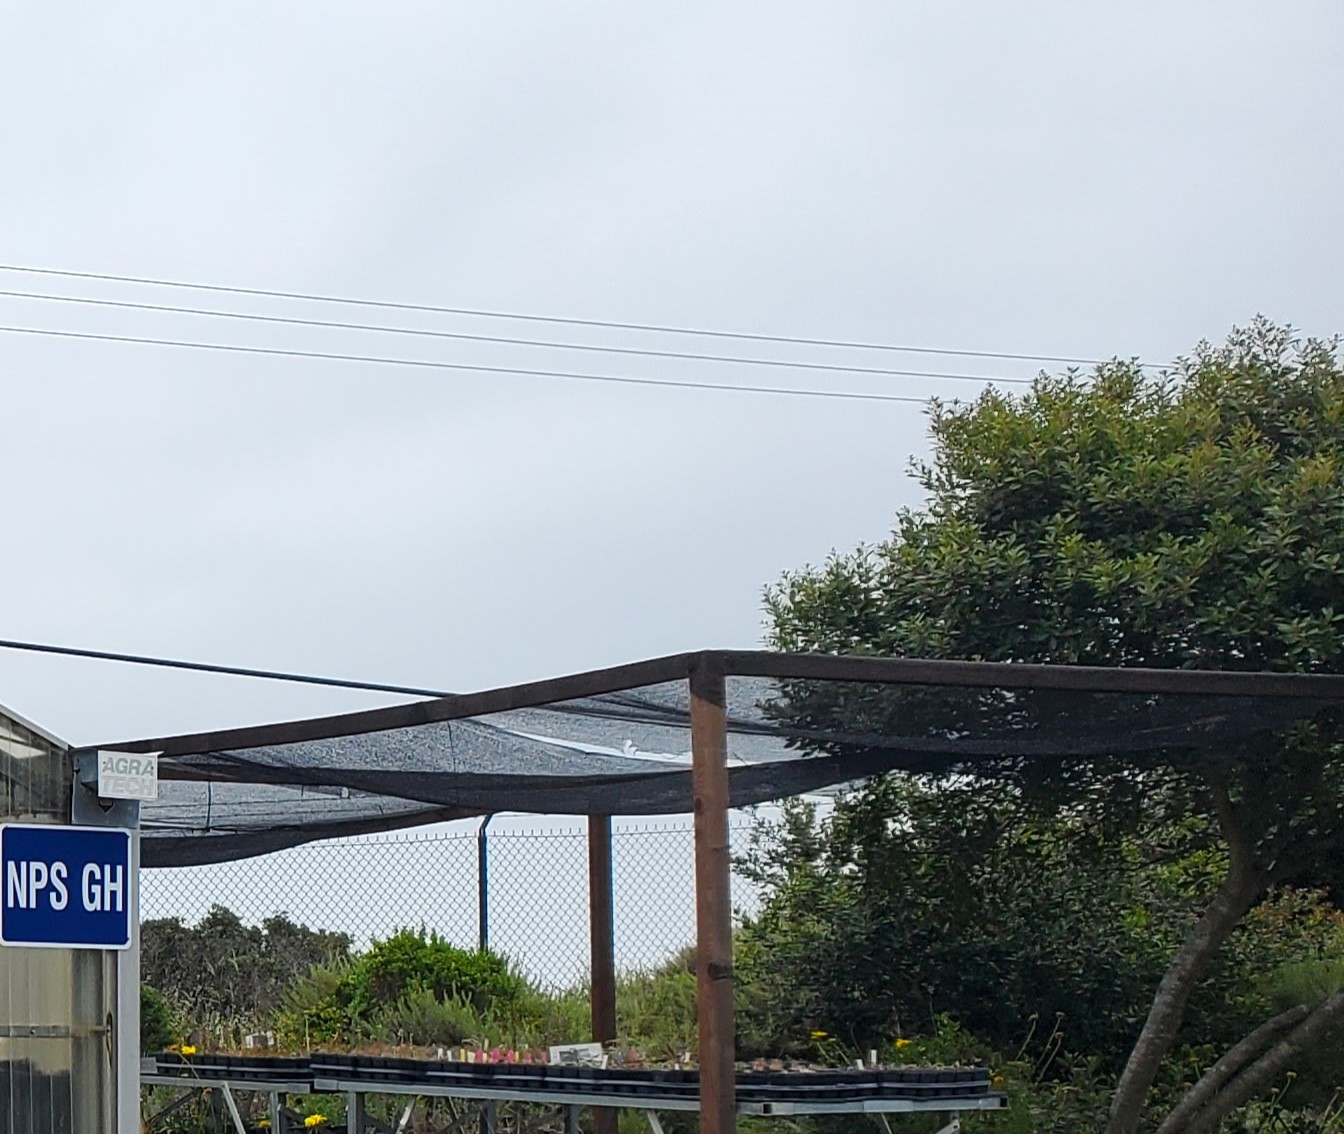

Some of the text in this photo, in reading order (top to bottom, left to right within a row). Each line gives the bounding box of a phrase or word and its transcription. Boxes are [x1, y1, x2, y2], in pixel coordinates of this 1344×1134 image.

[102, 756, 154, 777] AGRA
[6, 860, 124, 913] NPS GH
